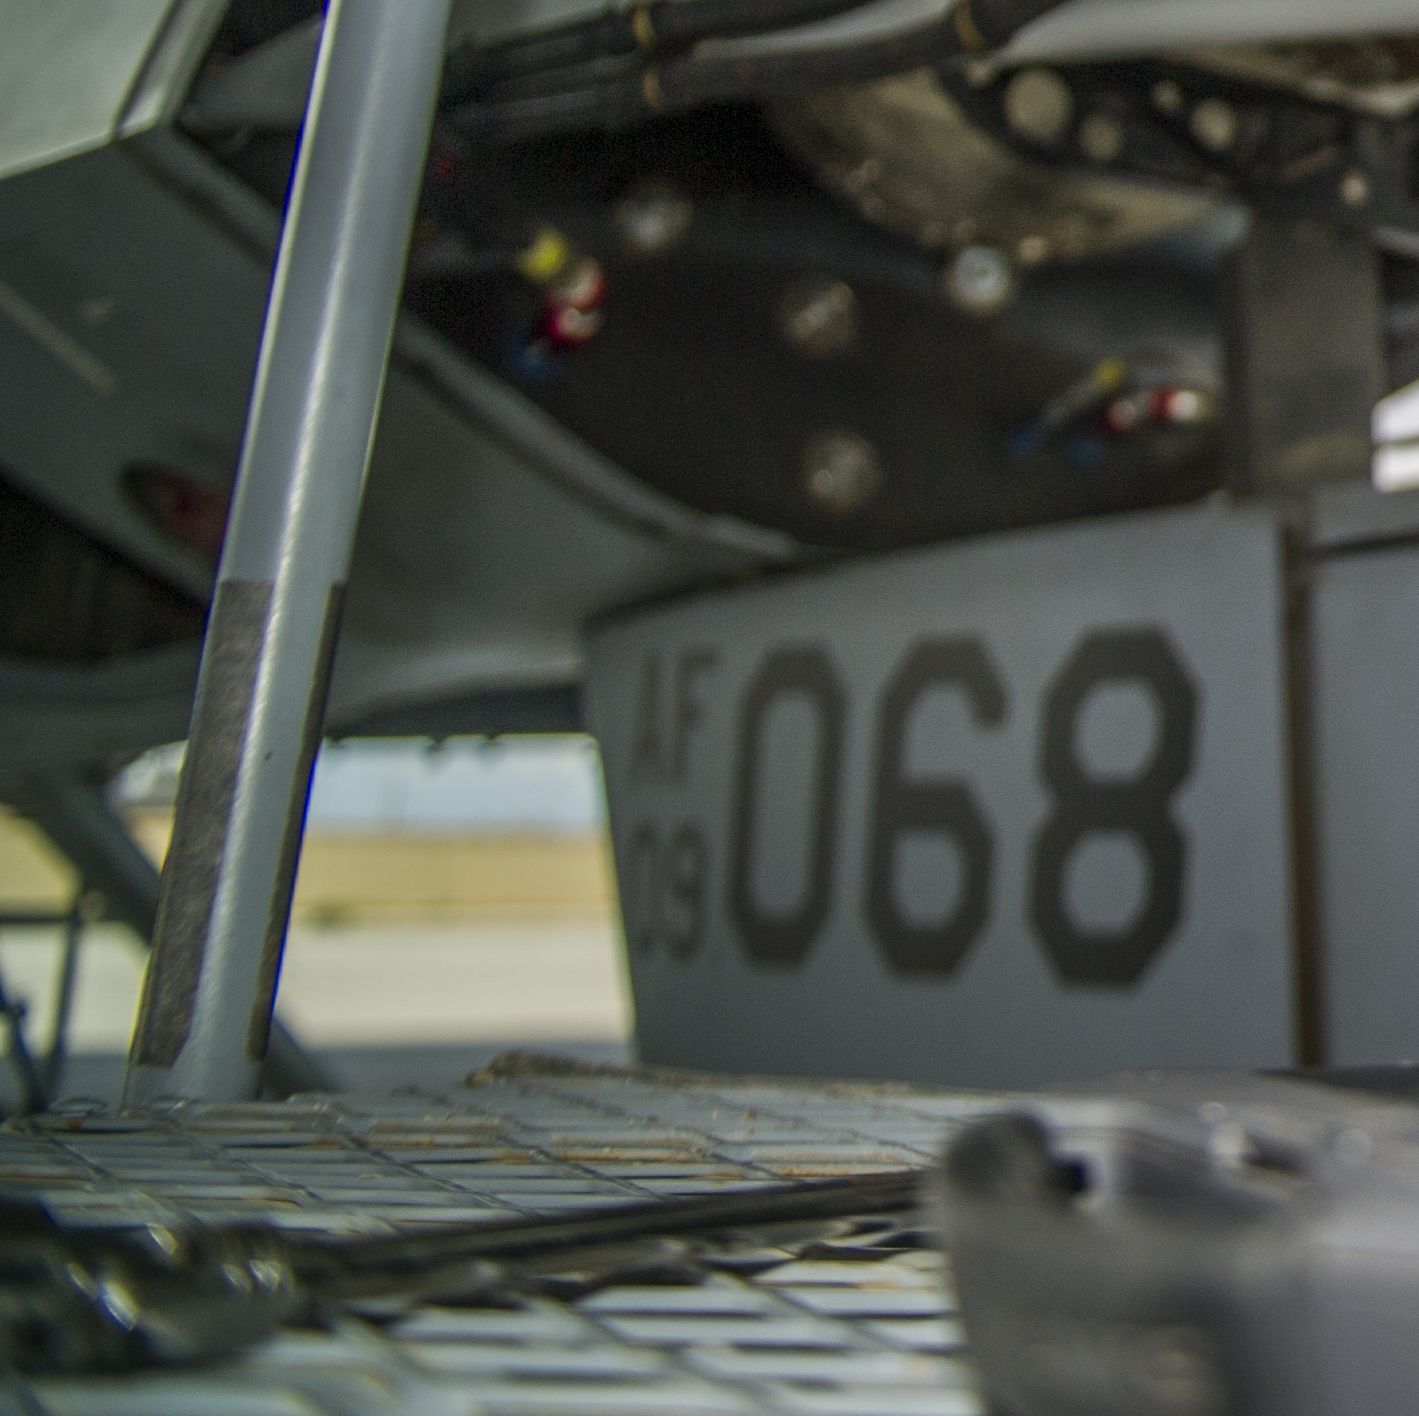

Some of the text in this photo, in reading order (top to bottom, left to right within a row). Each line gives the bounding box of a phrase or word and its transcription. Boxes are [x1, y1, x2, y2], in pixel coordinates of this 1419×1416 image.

[628, 642, 722, 782] AF
[725, 620, 1204, 992] 068
[624, 816, 710, 966] 09
